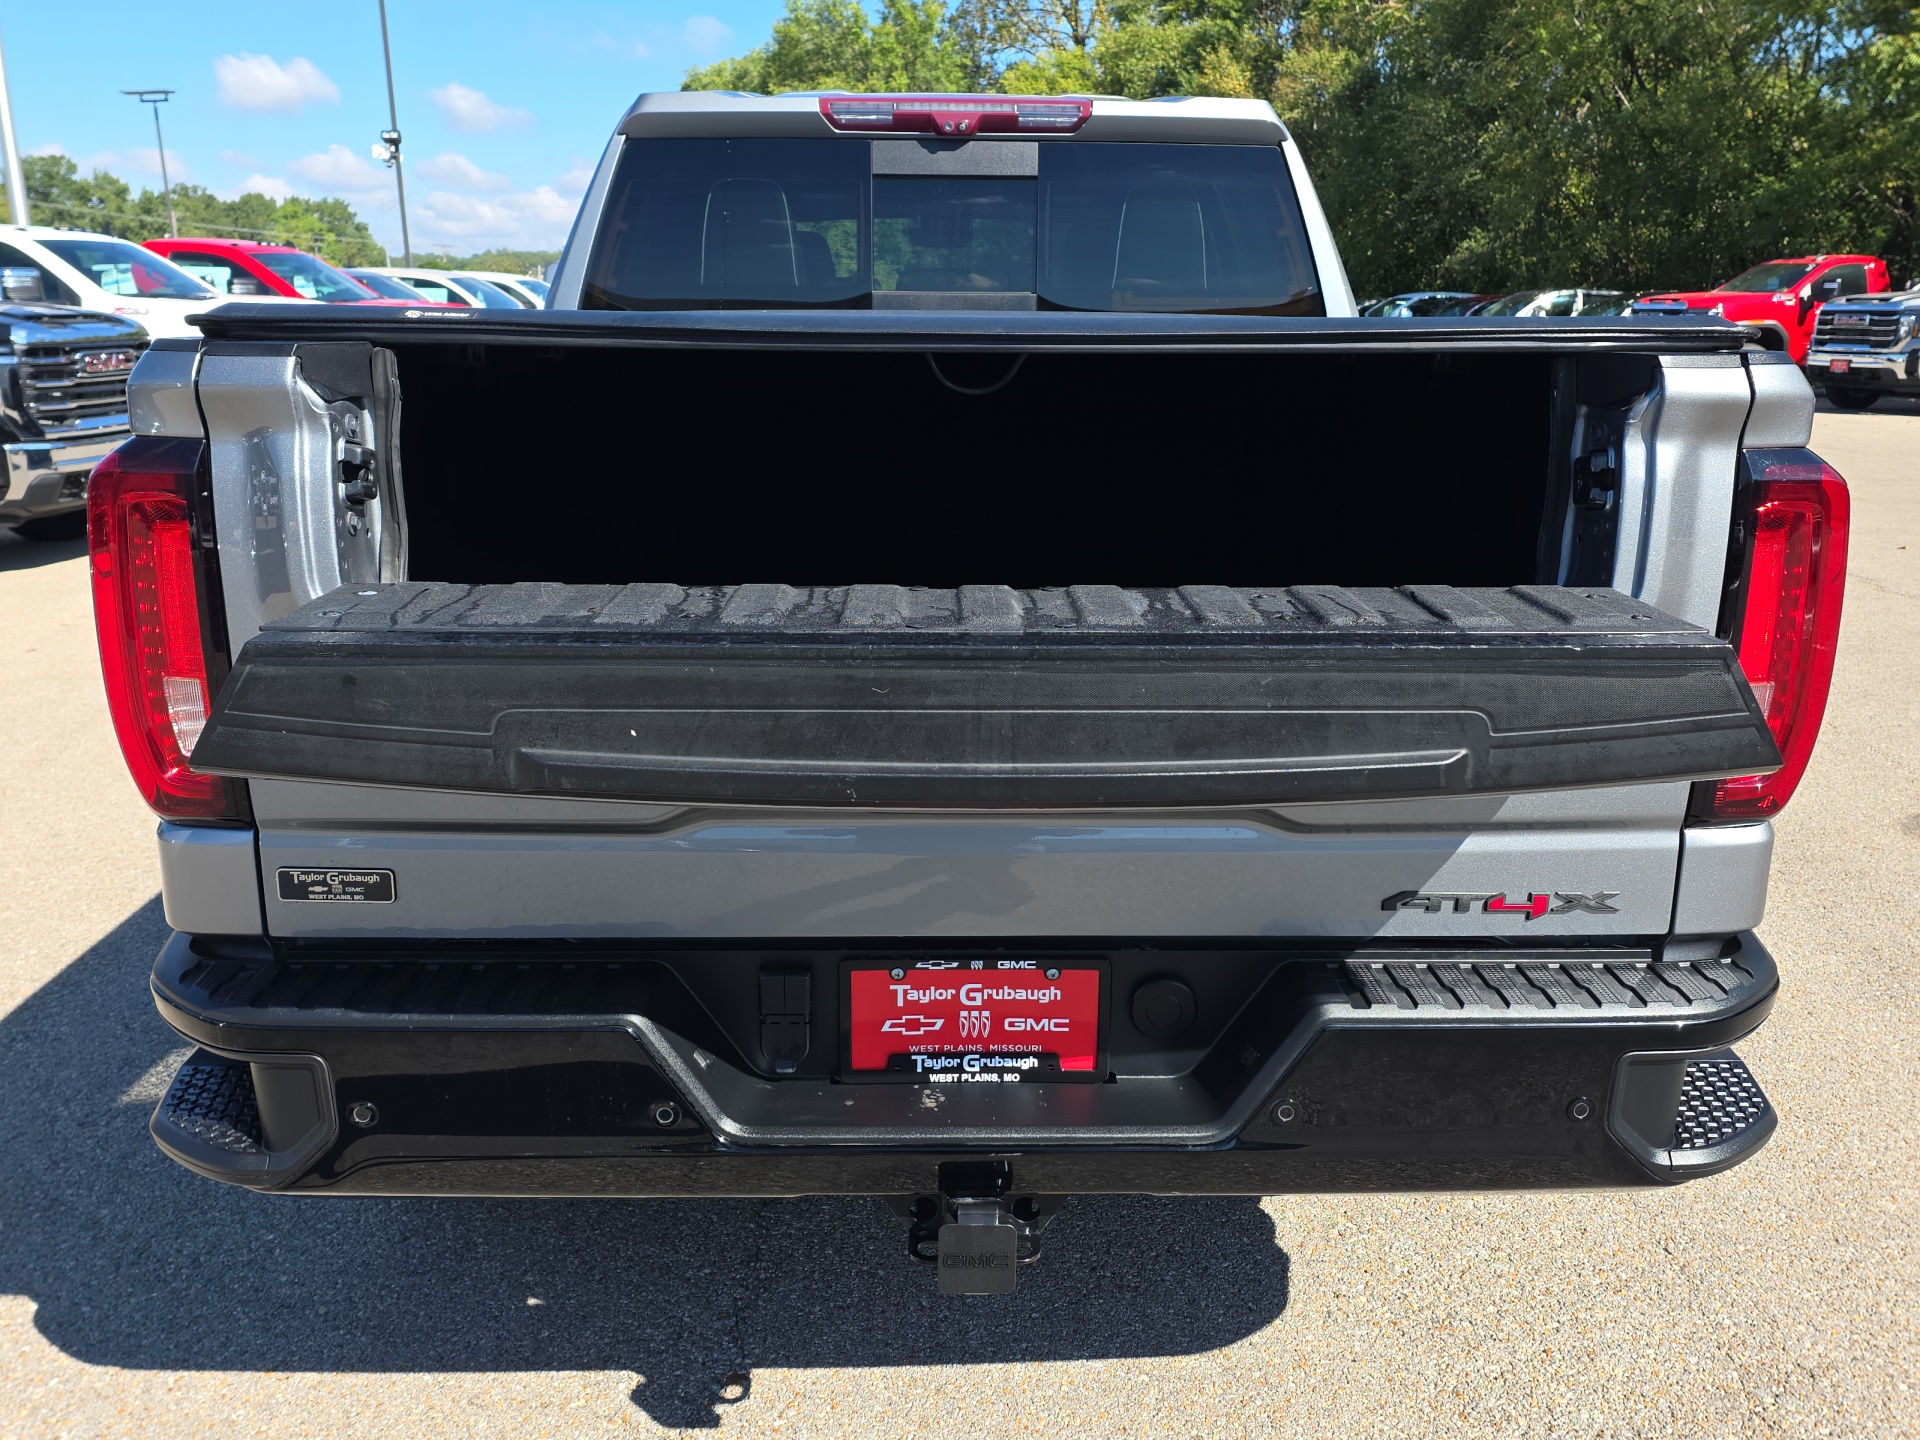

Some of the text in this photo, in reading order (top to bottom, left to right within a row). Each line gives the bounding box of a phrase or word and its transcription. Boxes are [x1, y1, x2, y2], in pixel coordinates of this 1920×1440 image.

[290, 872, 380, 884] Taylor Grubaugh
[1381, 891, 1620, 922] AT4X
[997, 961, 1036, 969] GMC
[890, 984, 1061, 1007] Taylor Grubaugh
[1004, 1018, 1069, 1032] GMC
[944, 1045, 985, 1053] PLAINS,
[911, 1055, 1038, 1072] Taylor Grubaugh
[929, 1074, 1020, 1083] WEST PLAINS, MO
[942, 1253, 1009, 1268] GMC
